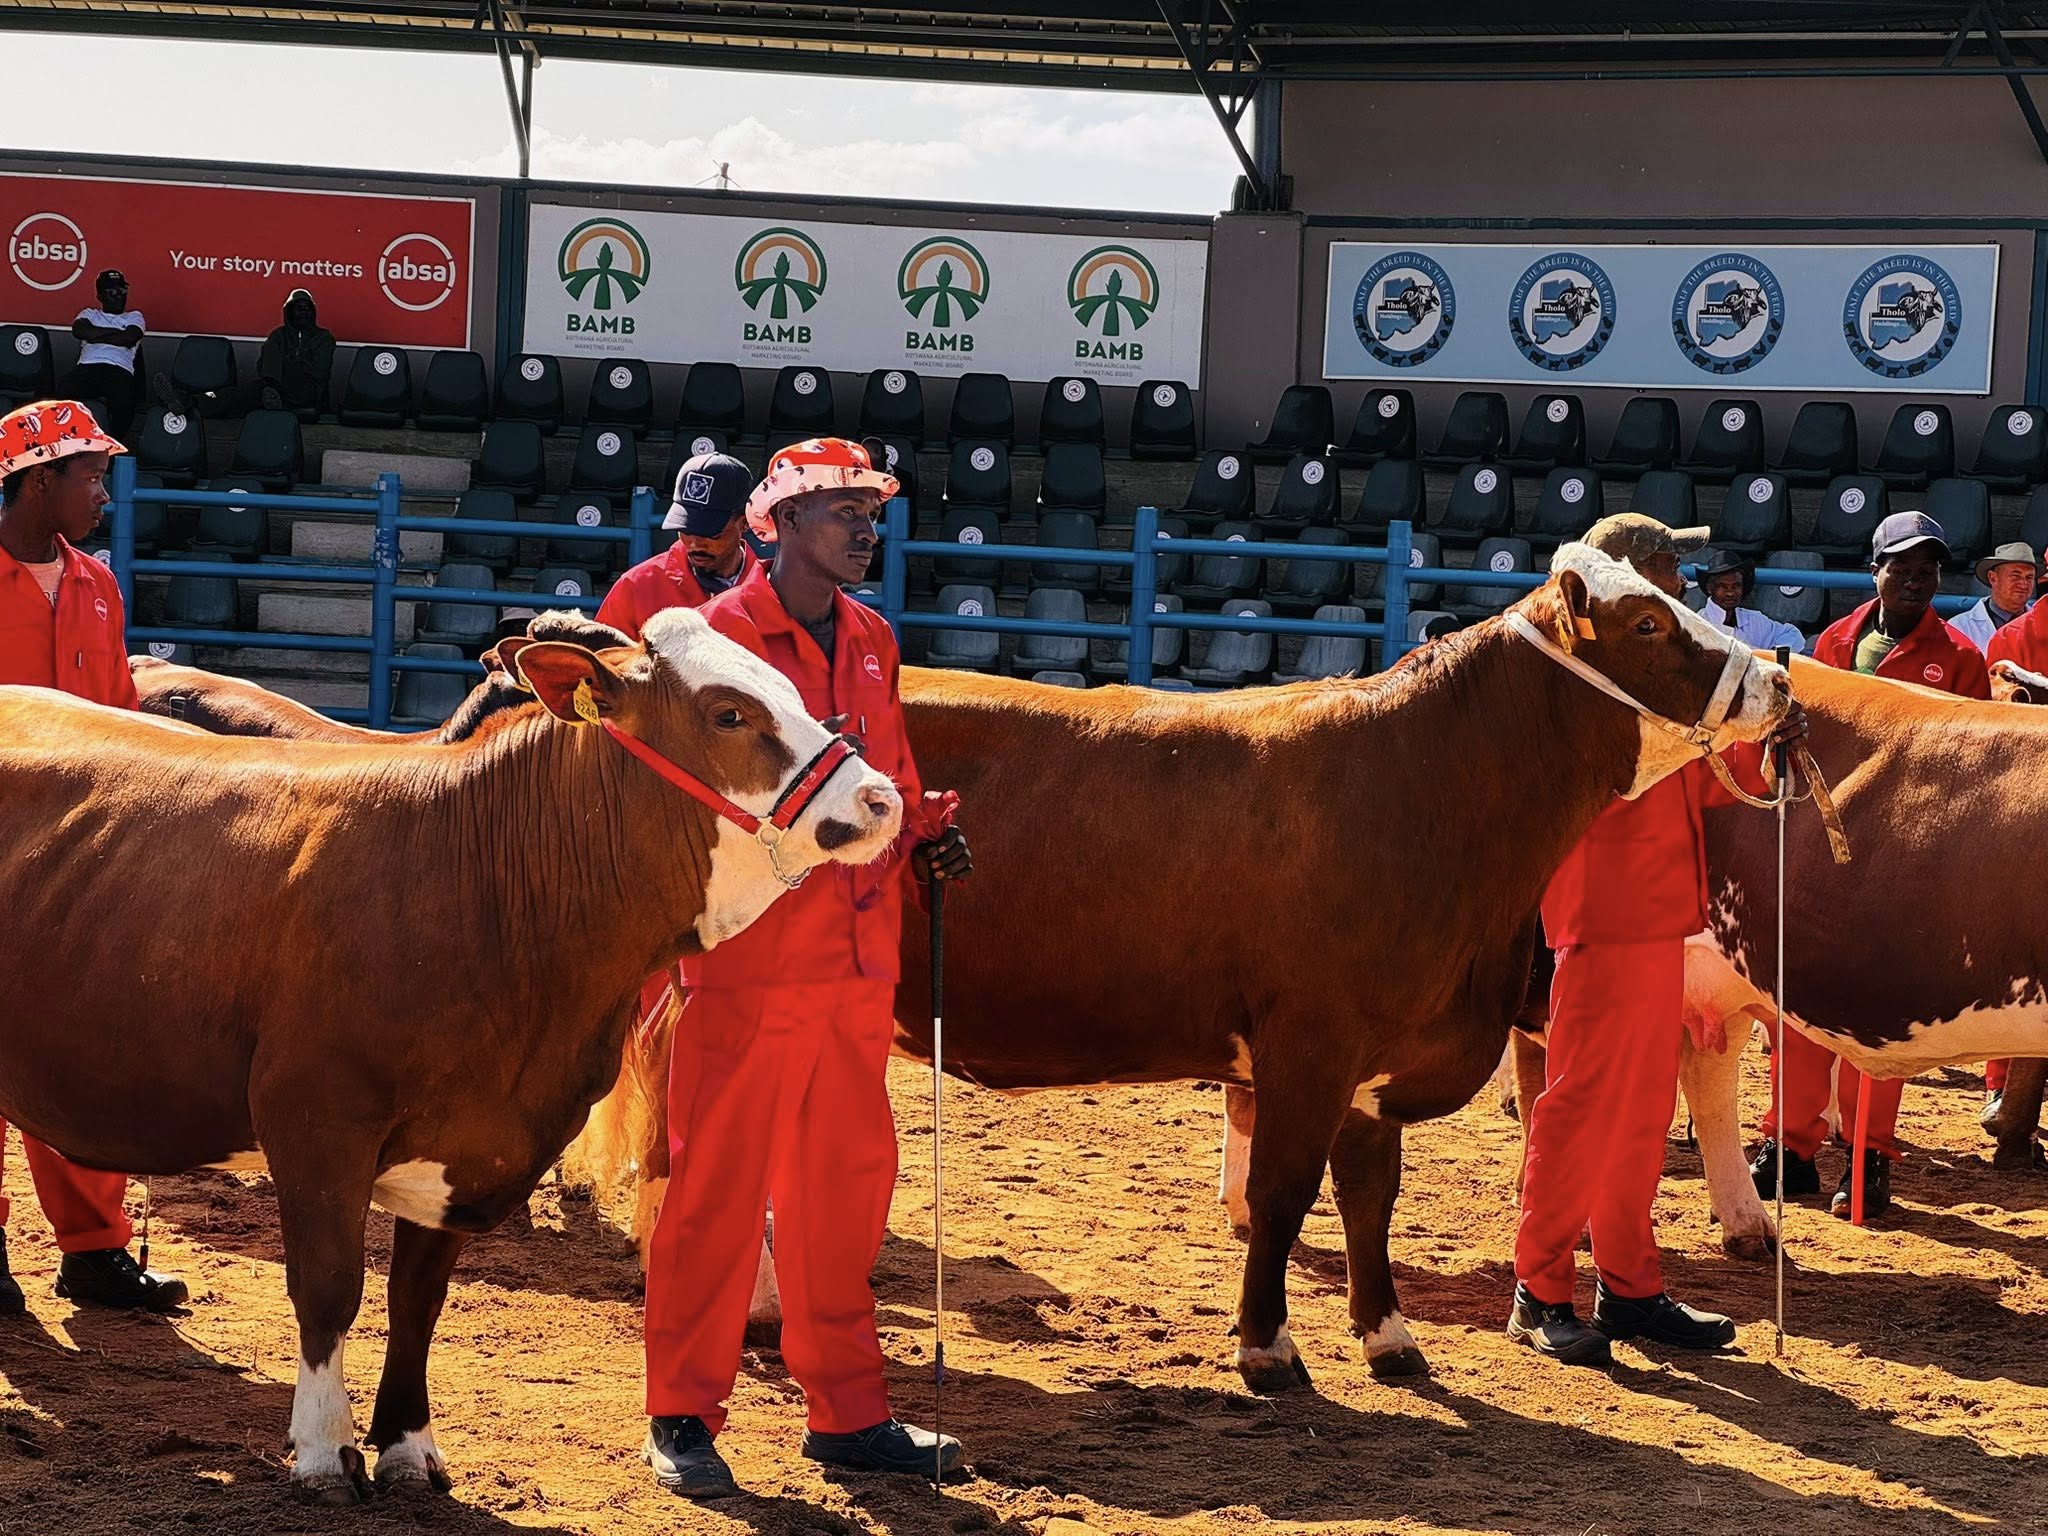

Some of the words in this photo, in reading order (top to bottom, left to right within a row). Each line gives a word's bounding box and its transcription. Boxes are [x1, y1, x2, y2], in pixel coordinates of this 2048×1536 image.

[18, 235, 78, 262] absa
[170, 250, 217, 270] Your
[222, 255, 275, 278] story
[280, 260, 363, 278] matters
[387, 256, 447, 282] absa
[1357, 287, 1368, 310] HALF
[1366, 268, 1380, 283] THE
[1382, 255, 1410, 269] BREED
[1423, 260, 1433, 270] IN
[1433, 269, 1447, 287] THE
[1443, 288, 1453, 312] FEED
[1512, 288, 1524, 313] HALF
[1523, 270, 1537, 285] THE
[1539, 256, 1568, 269] BREED
[1571, 257, 1580, 265] IS
[1581, 261, 1592, 271] IN
[1592, 270, 1608, 287] THE
[1603, 289, 1612, 314] FEED
[1676, 288, 1689, 315] HALF
[1687, 269, 1704, 286] THE
[1704, 257, 1735, 271] BREED
[1737, 258, 1747, 266] IS
[1748, 262, 1760, 273] IN
[1759, 271, 1775, 289] THE
[1771, 291, 1780, 316] FEED
[1847, 290, 1861, 317] HALF
[1859, 271, 1877, 287] THE
[1876, 258, 1909, 273] BREED
[1912, 259, 1921, 268] IS
[1923, 263, 1936, 274] IN
[1935, 273, 1951, 292] THE
[1946, 294, 1957, 320] FEED
[1387, 302, 1408, 310] Tholo
[1544, 304, 1566, 312] Tholo
[1709, 306, 1732, 314] Tholo
[1881, 308, 1906, 316] Tholo
[567, 313, 635, 334] BAMB
[743, 323, 812, 343] BAMB
[906, 331, 974, 352] BAMB
[1075, 340, 1143, 361] BAMB
